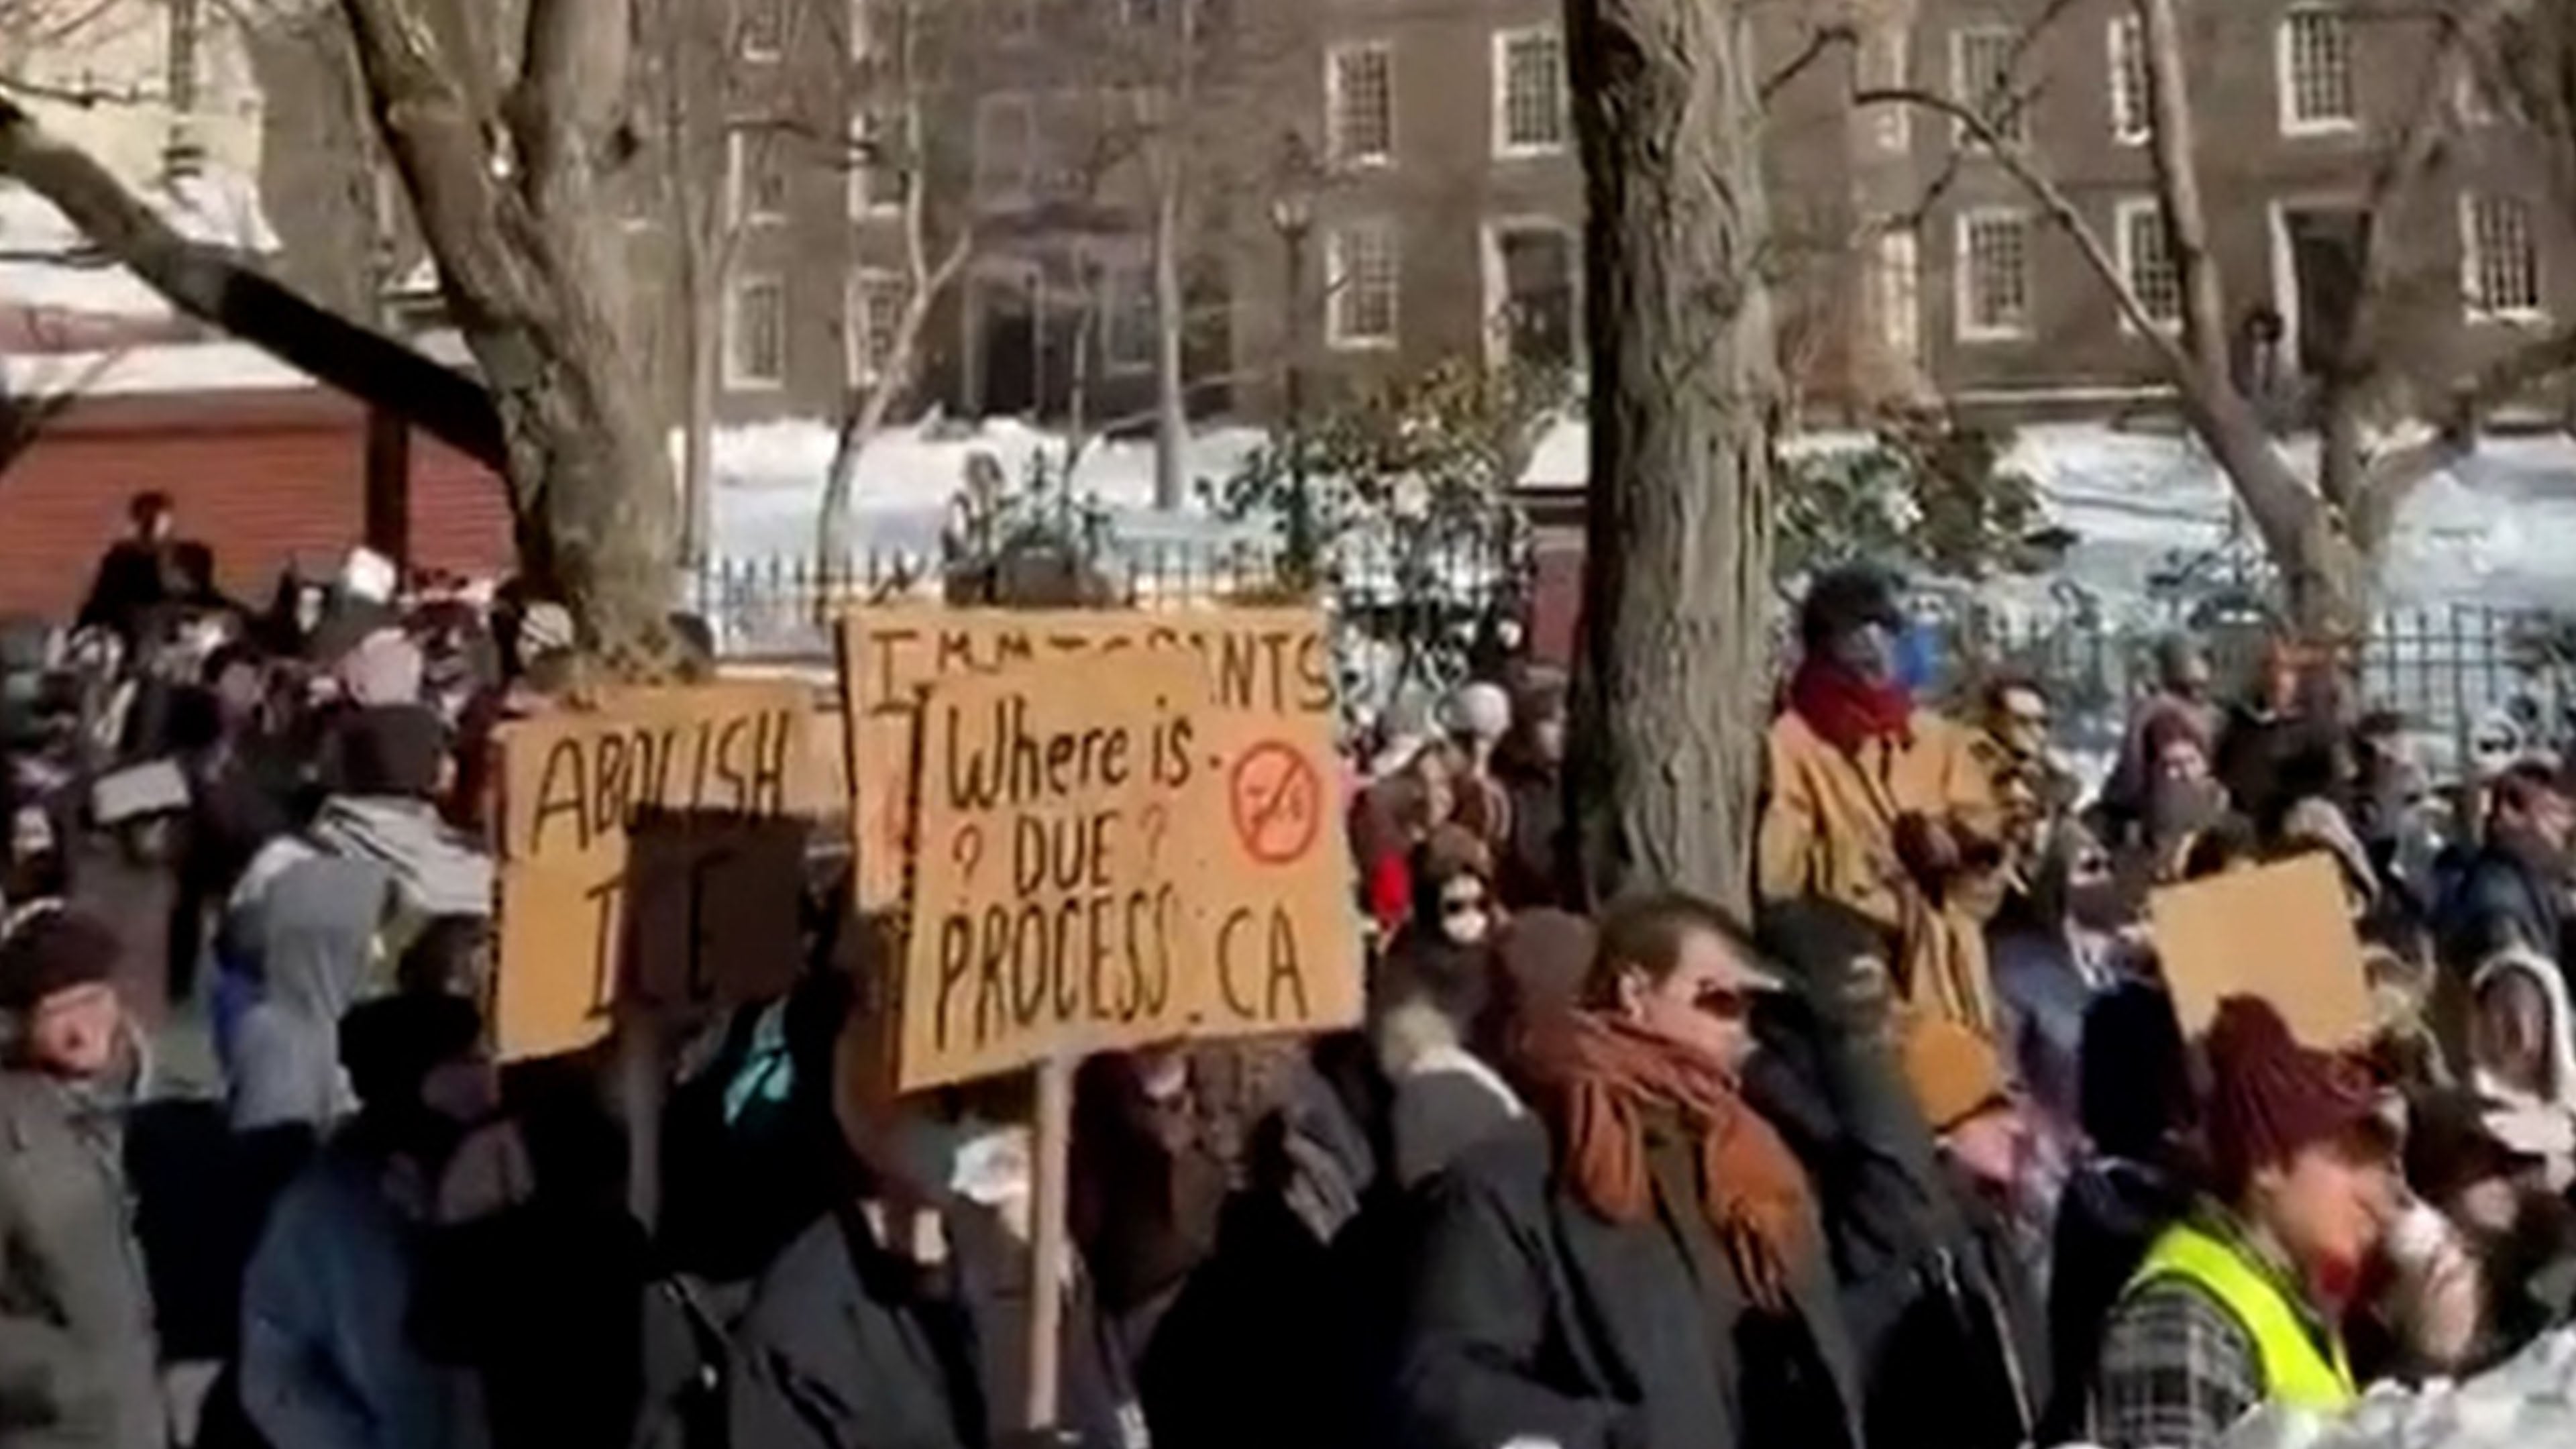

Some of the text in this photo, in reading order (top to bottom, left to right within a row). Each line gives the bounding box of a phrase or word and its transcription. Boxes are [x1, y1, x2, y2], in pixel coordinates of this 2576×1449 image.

[868, 625, 1336, 716] IMNTS
[530, 708, 792, 856] ABOLISH
[947, 694, 1193, 810] Where is
[1014, 810, 1120, 898] DUE
[936, 883, 1174, 1051] PROCESS
